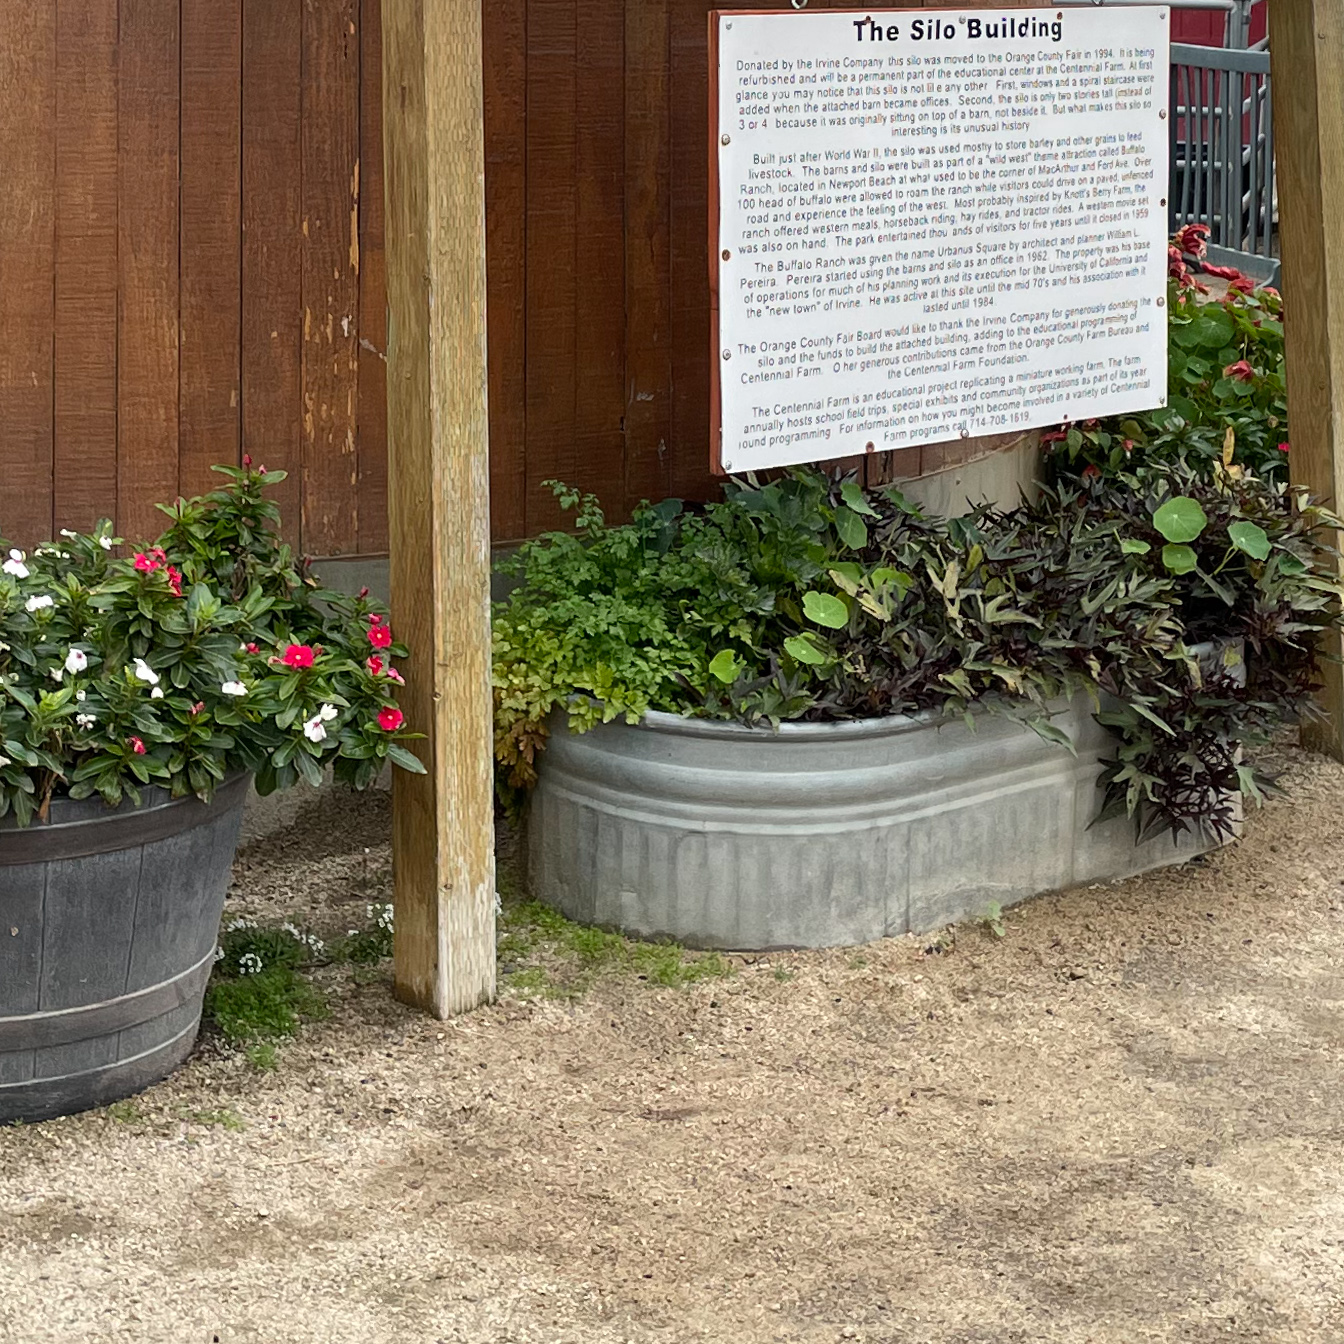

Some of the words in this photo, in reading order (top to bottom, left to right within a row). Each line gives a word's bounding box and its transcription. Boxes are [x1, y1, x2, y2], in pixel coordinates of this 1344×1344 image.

[853, 19, 900, 42] The
[910, 18, 956, 41] Silo
[966, 16, 1063, 42] Building
[736, 60, 778, 70] Donated
[782, 59, 793, 72] by
[796, 59, 812, 69] the
[815, 59, 840, 68] Irvine
[843, 57, 883, 68] Company
[923, 56, 941, 64] was
[739, 74, 795, 85] refurbished
[798, 74, 816, 84] and
[858, 71, 904, 81] permanent
[906, 70, 924, 80] part
[735, 91, 768, 103] glance
[772, 91, 790, 101] you
[793, 89, 814, 98] may
[817, 88, 844, 97] notice
[739, 104, 770, 115] added
[773, 104, 800, 113] when
[821, 101, 859, 111] attached
[862, 101, 880, 110] barn
[883, 99, 917, 108] became
[775, 118, 817, 128] because
[828, 117, 846, 125] was
[753, 153, 774, 164] Built
[799, 153, 821, 162] after
[824, 150, 850, 160] World
[853, 148, 870, 158] War
[938, 144, 960, 153] used
[802, 165, 820, 176] The
[823, 166, 848, 175] barns
[851, 163, 867, 173] and
[887, 162, 908, 170] were
[946, 157, 963, 168] part
[778, 181, 814, 192] located
[829, 178, 866, 189] Newport
[868, 175, 896, 186] Beach
[933, 172, 954, 182] used
[737, 198, 755, 209] 100
[758, 197, 783, 208] head
[799, 194, 831, 205] buffalo
[834, 194, 856, 203] were
[859, 190, 892, 201] allowed
[906, 189, 929, 197] roam
[746, 213, 769, 224] road
[772, 212, 791, 222] and
[794, 209, 846, 221] experience
[866, 204, 895, 215] feeling
[742, 228, 770, 238] ranch
[773, 224, 808, 236] offered
[812, 223, 848, 233] western
[883, 216, 928, 227] horseback
[738, 244, 758, 253] was
[761, 242, 782, 252] also
[835, 235, 852, 246] The
[855, 235, 874, 246] park
[877, 230, 926, 242] entertained
[754, 262, 773, 272] The
[777, 259, 812, 271] Buffalo
[815, 256, 845, 268] Ranch
[848, 256, 866, 265] was
[911, 249, 935, 259] name
[937, 246, 973, 256] Urbanus
[786, 274, 822, 284] Pereira
[825, 270, 857, 282] started
[860, 269, 883, 279] using
[902, 264, 925, 274] barns
[928, 261, 944, 271] and
[756, 290, 809, 302] operations
[812, 287, 825, 297] for
[828, 285, 853, 295] much
[882, 279, 918, 292] planning
[920, 276, 941, 285] work
[943, 273, 959, 283] and
[883, 295, 900, 303] was
[737, 343, 756, 353] The
[759, 341, 796, 352] Orange
[800, 336, 833, 348] County
[836, 333, 853, 343] Fair
[856, 329, 882, 341] Board
[939, 319, 963, 330] thank
[758, 356, 774, 367] silo
[777, 354, 796, 365] and
[817, 349, 842, 360] funds
[740, 369, 793, 384] Centennial
[859, 356, 899, 369] generous
[887, 369, 901, 379] the
[904, 362, 950, 376] Centennial
[752, 406, 770, 417] The
[773, 400, 823, 415] Centennial
[827, 397, 849, 407] Farm
[875, 386, 925, 400] educational
[927, 381, 957, 394] project
[743, 420, 784, 433] annually
[787, 416, 812, 427] hosts
[815, 411, 844, 424] school
[847, 407, 865, 418] field
[892, 400, 922, 412] special
[925, 395, 958, 407] exhibits
[769, 428, 831, 445] programming
[839, 423, 853, 433] For
[856, 417, 905, 431] information
[921, 412, 939, 421] how
[941, 410, 957, 419] you
[884, 430, 906, 441] Farm
[909, 424, 950, 439] programs
